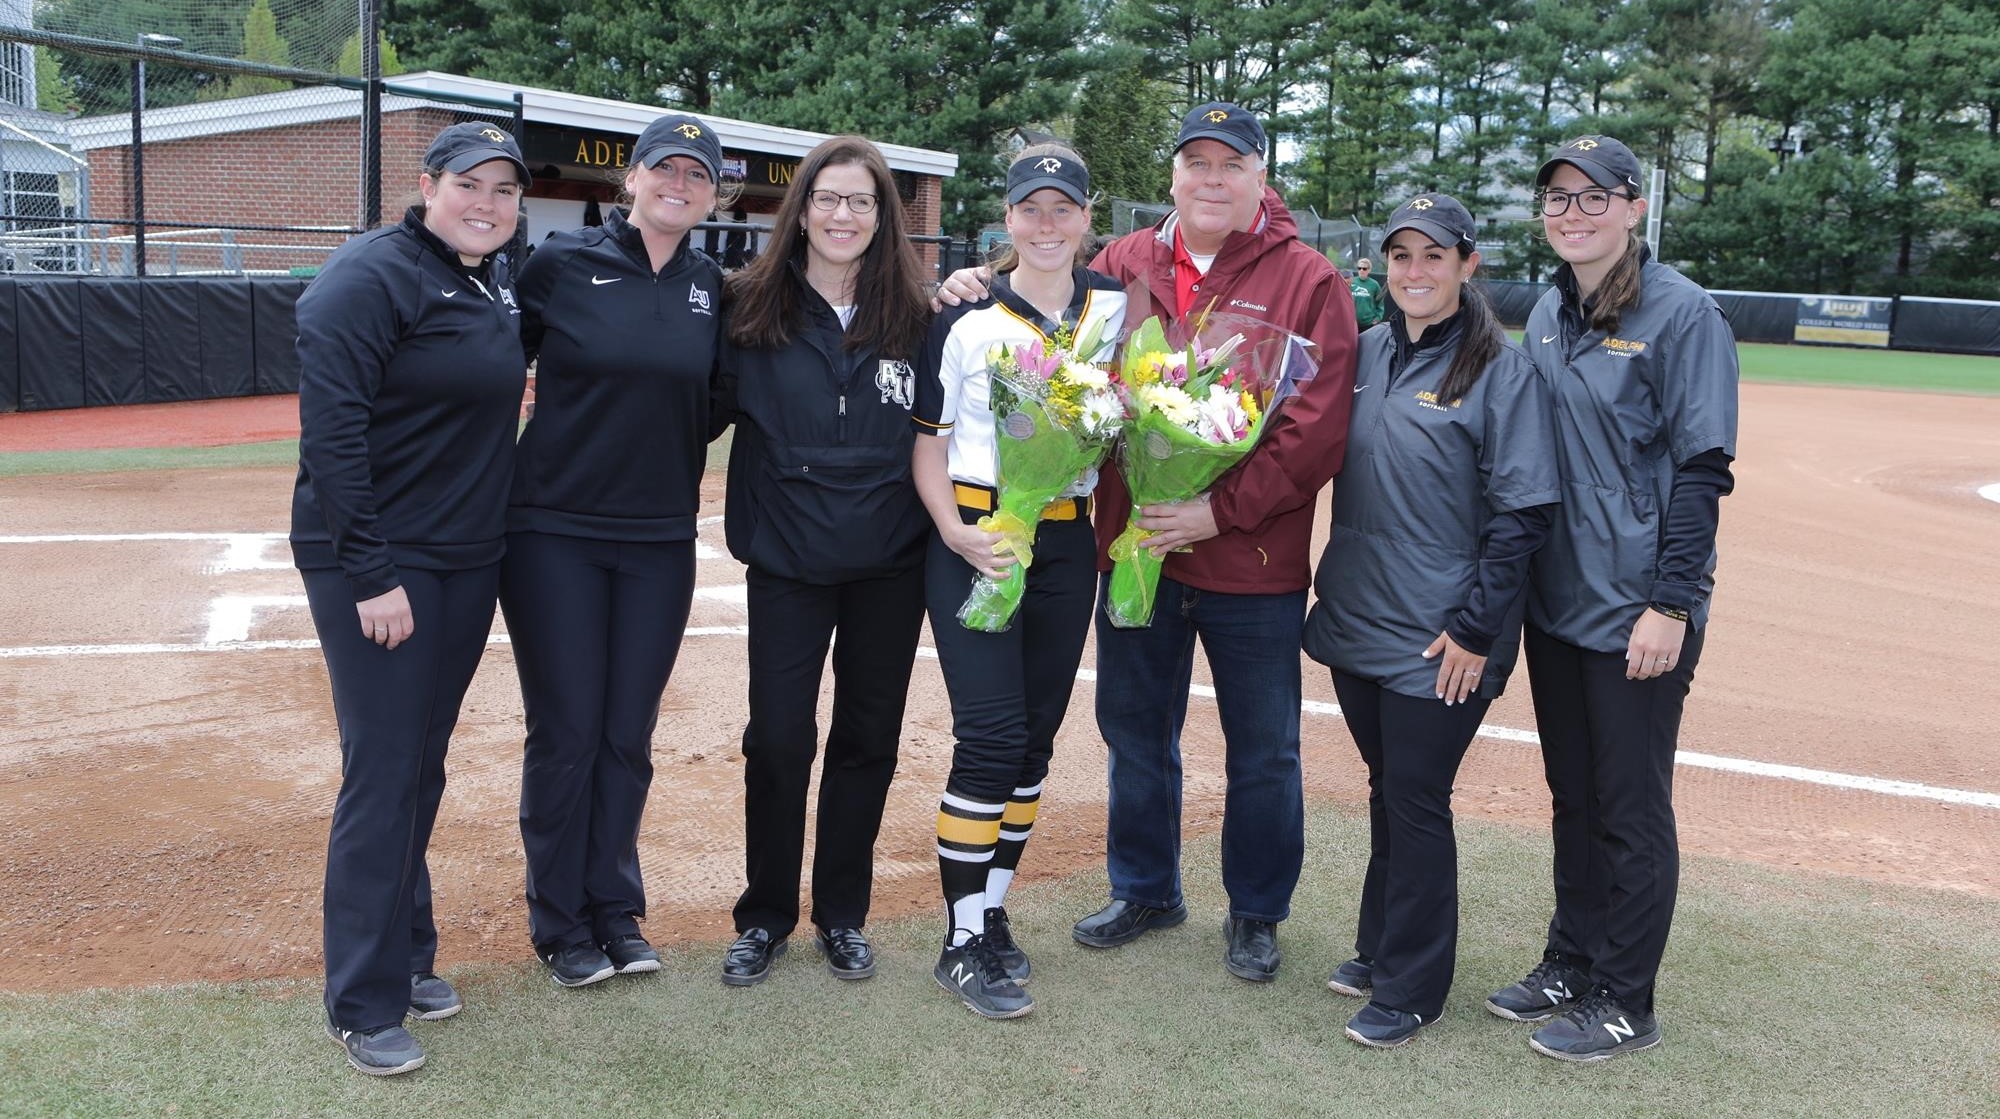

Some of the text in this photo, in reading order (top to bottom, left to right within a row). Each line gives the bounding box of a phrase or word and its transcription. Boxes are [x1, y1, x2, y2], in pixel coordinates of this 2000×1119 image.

[575, 138, 626, 168] ADE
[1236, 300, 1267, 312] Columbia
[1799, 319, 1889, 330] COLLEGE WORLD SERIES
[1601, 336, 1647, 353] ADELPHI
[1607, 349, 1632, 357] SOFTBALL
[1418, 401, 1448, 412] SOFTBALL
